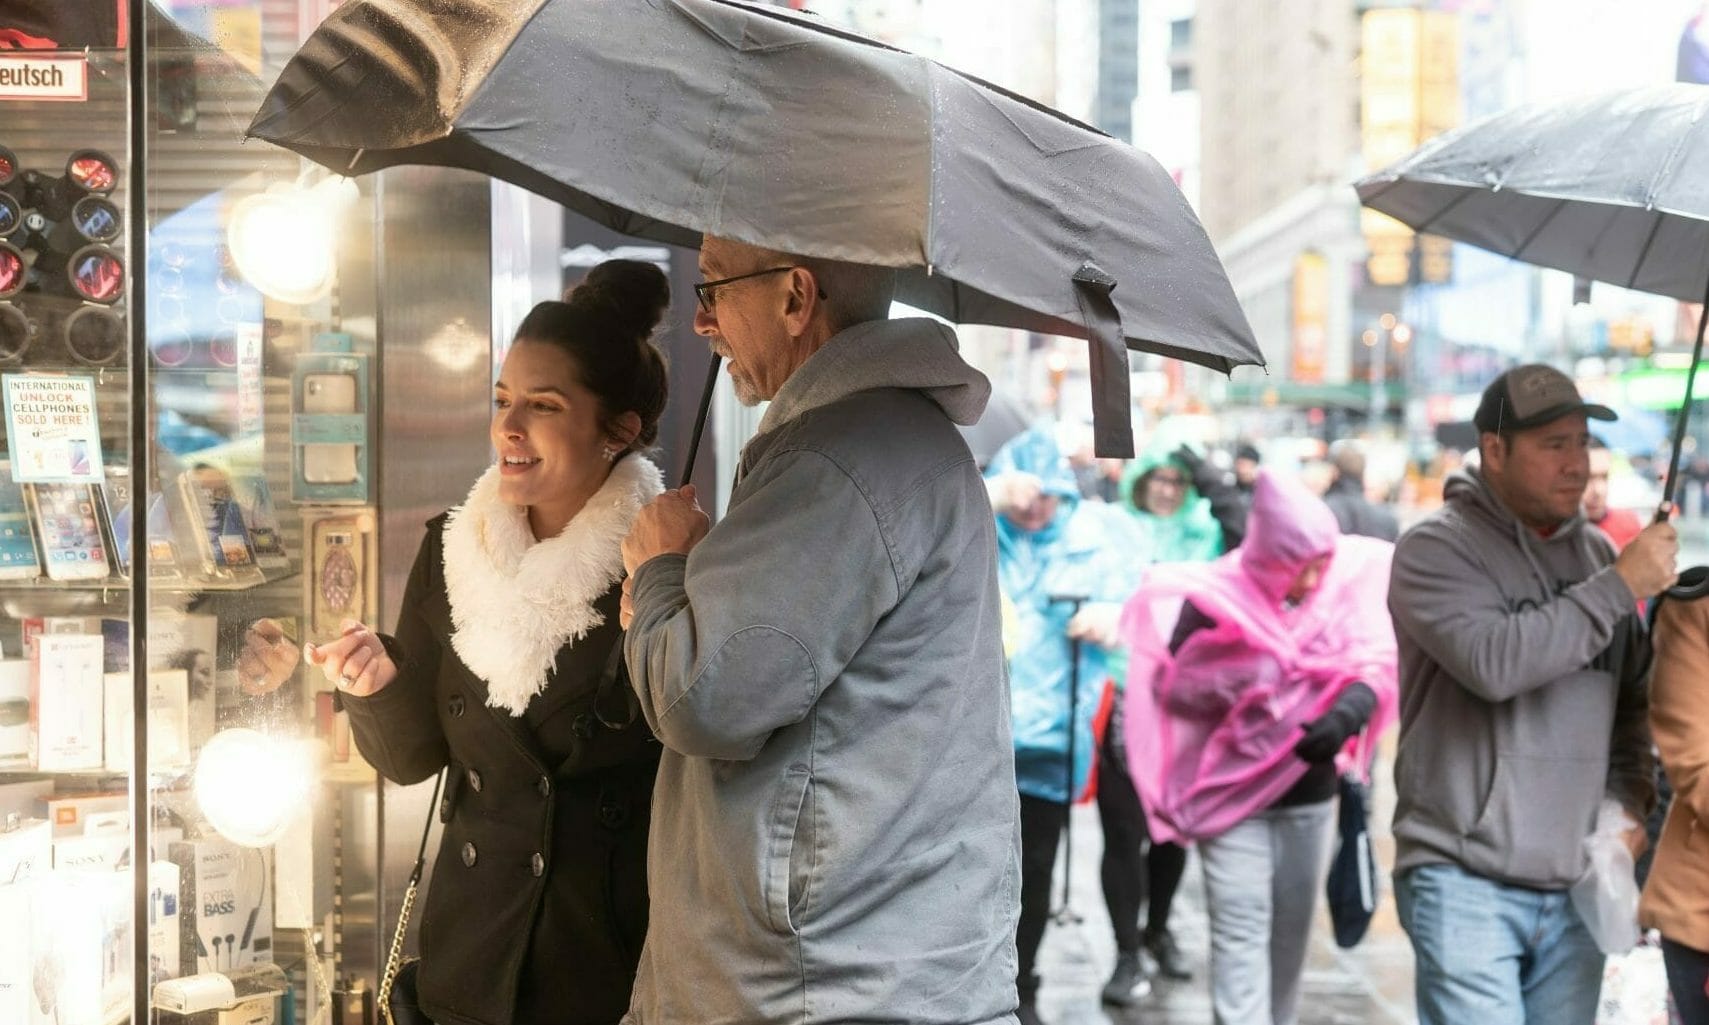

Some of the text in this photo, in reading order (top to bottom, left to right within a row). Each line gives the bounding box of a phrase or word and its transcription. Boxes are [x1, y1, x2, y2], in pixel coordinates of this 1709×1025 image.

[10, 381, 88, 391] INTERNATIONAL
[20, 393, 74, 402] UNLOCK
[13, 403, 90, 413] CELLPHONES
[17, 415, 47, 425] SOLD
[203, 888, 235, 901] EXTRA
[203, 900, 236, 917] BASS
